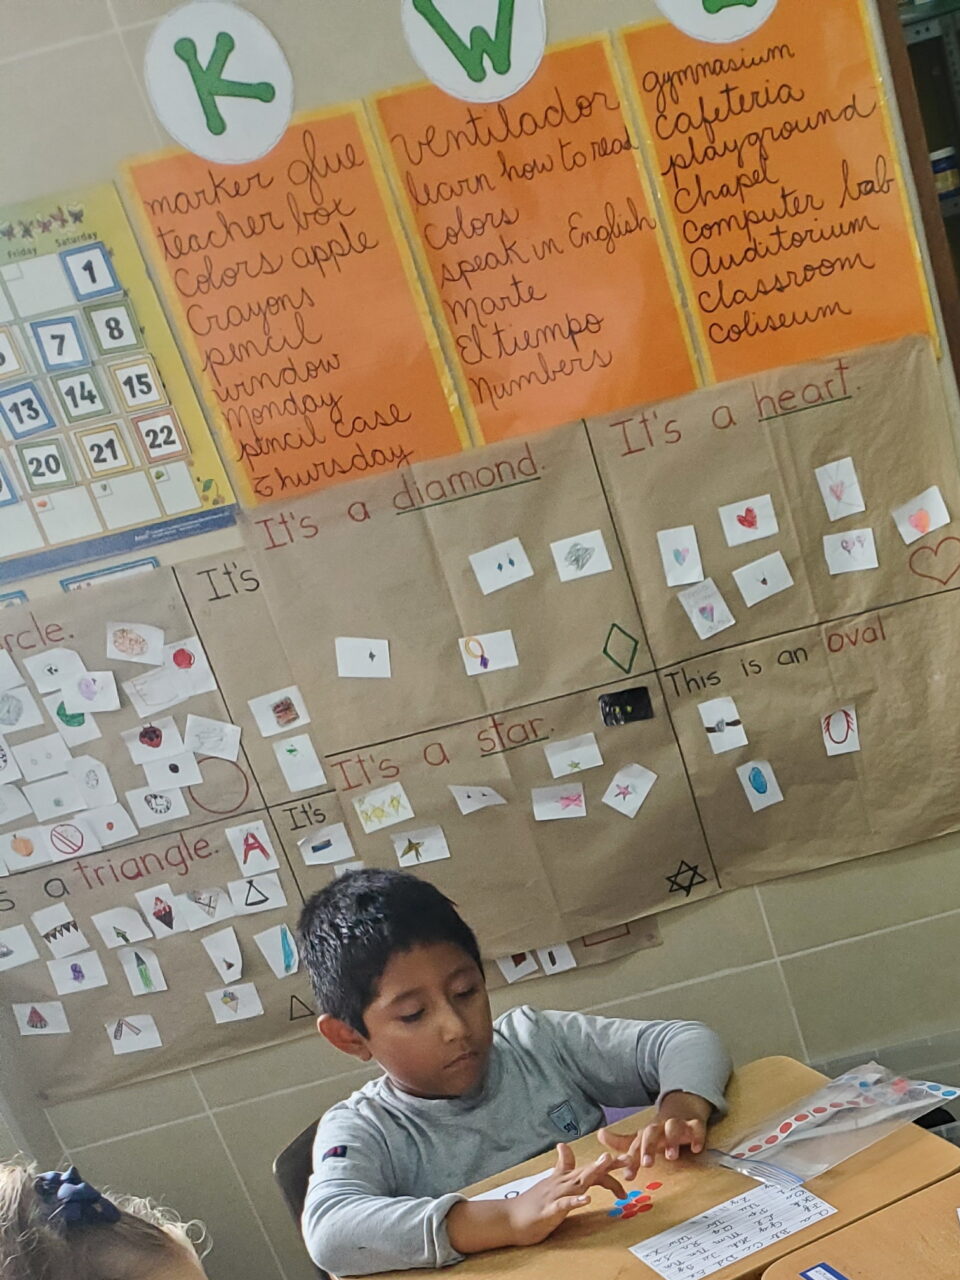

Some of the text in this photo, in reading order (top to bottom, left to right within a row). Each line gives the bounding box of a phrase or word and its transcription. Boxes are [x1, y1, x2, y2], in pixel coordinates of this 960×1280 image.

[411, 0, 515, 82] W
[174, 32, 276, 135] K
[642, 44, 795, 113] gymnasium
[661, 94, 877, 189] playground
[145, 130, 365, 215] marker glue
[406, 126, 639, 212] learn how to read
[7, 231, 98, 259] Friday Saturday
[157, 211, 285, 262] teacher
[291, 221, 379, 278] apple
[441, 198, 656, 290] speak in English
[82, 260, 97, 284] 1
[51, 317, 124, 356] 7 8
[202, 311, 322, 386] pencil
[456, 313, 604, 365] El tiempo
[9, 373, 152, 424] 13 14 15
[28, 425, 176, 477] 20 21 22
[237, 416, 326, 471] pencil
[609, 411, 682, 457] It's
[711, 405, 737, 429] a
[254, 511, 319, 550] It's
[347, 501, 371, 523] a
[196, 562, 260, 602] It's
[0, 611, 74, 653] rcle.
[664, 614, 887, 697] This is an oval
[330, 753, 400, 792] It's
[423, 742, 450, 767] a
[282, 803, 327, 831] It's
[44, 877, 71, 898] a
